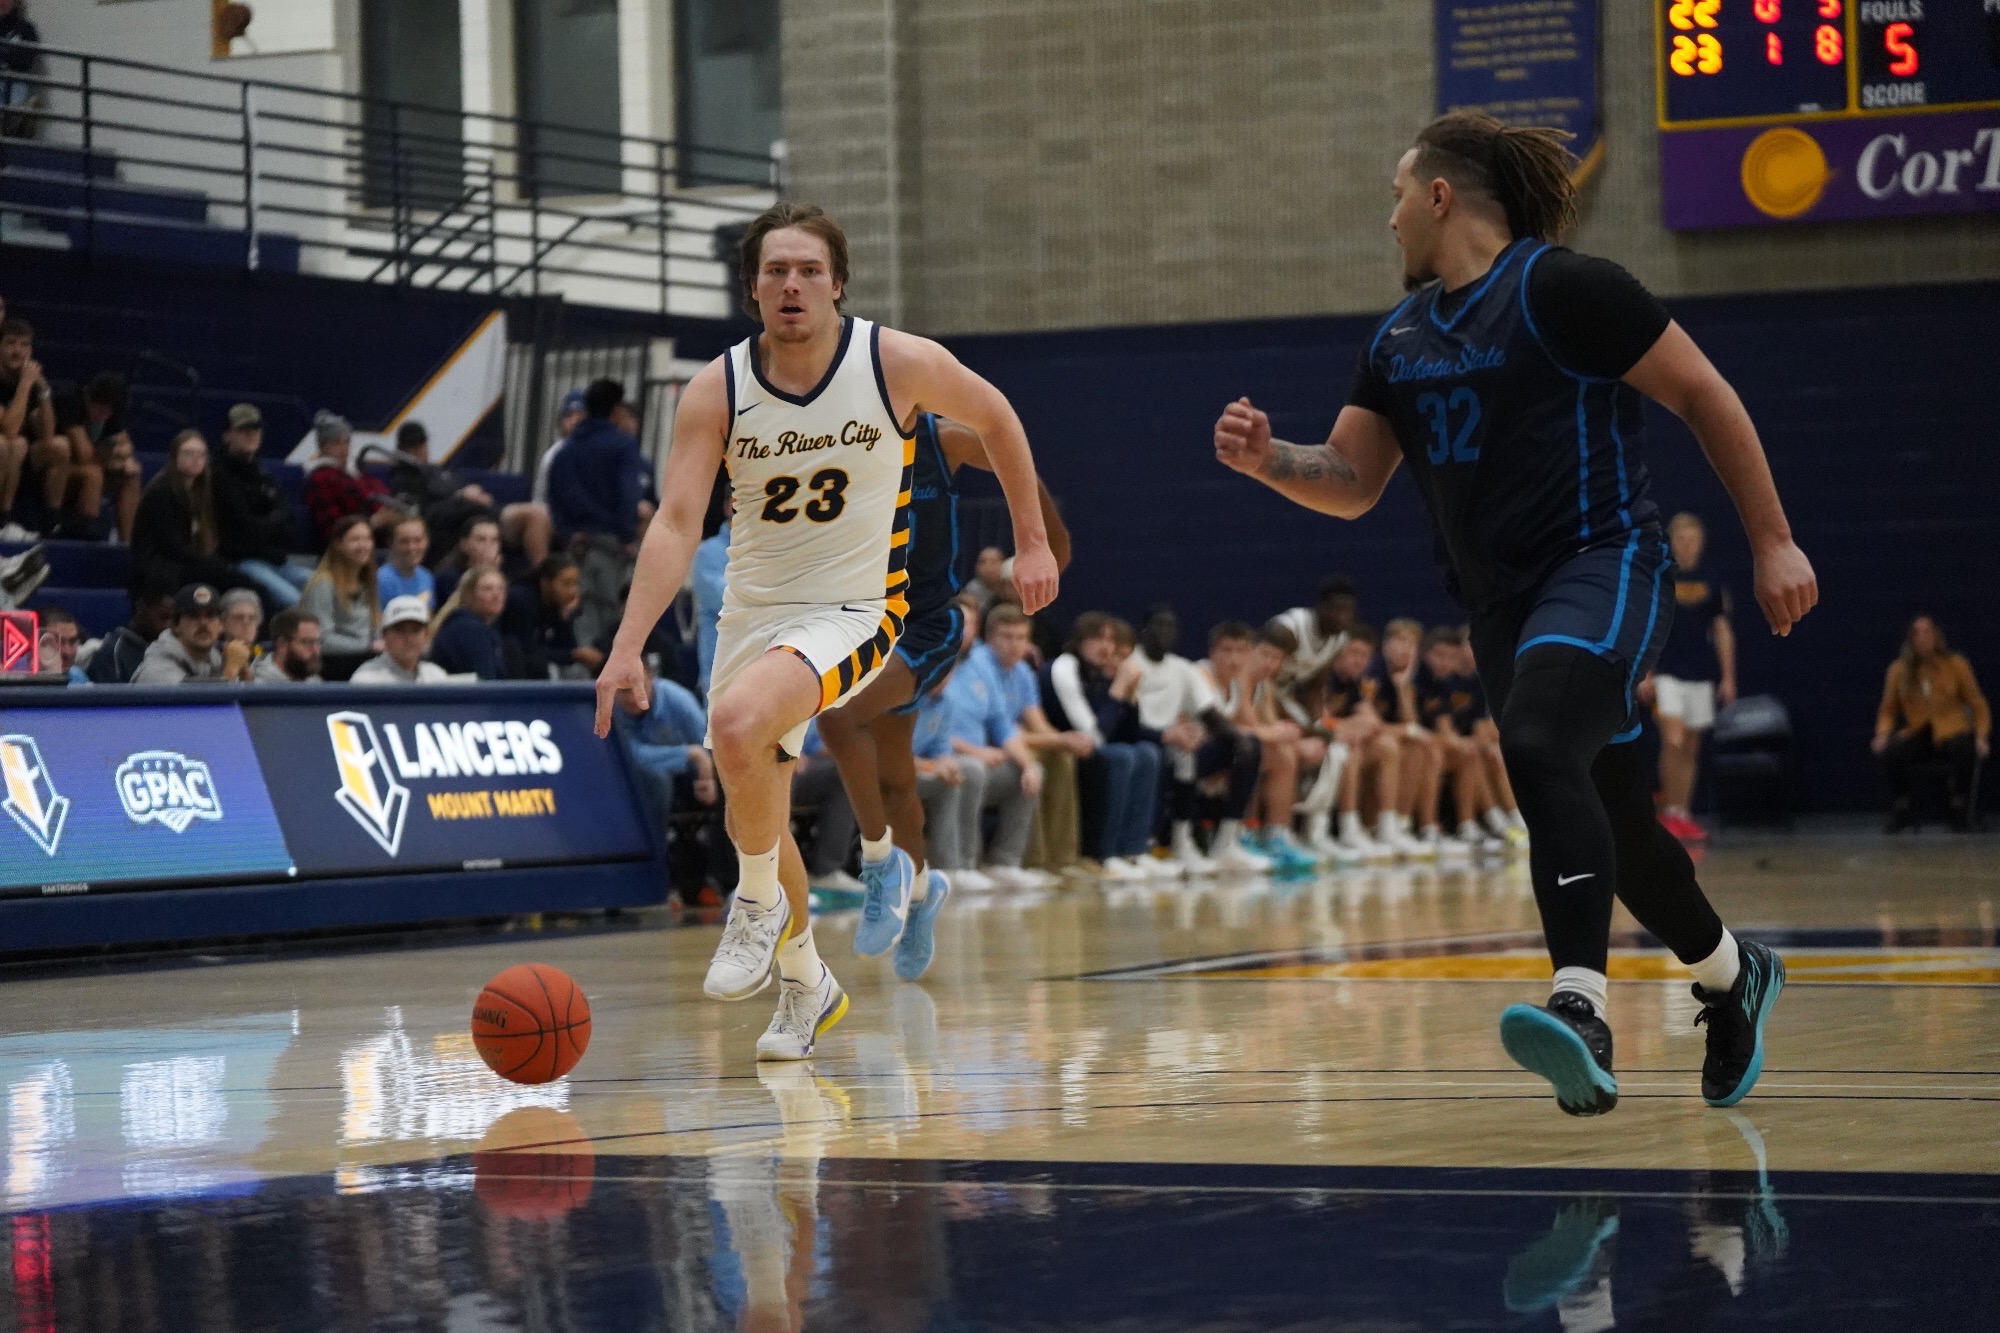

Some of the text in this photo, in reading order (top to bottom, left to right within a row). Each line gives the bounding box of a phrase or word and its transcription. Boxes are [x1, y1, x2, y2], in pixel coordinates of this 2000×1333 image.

[1860, 0, 1923, 22] FOULS
[1670, 24, 1843, 76] 23 1 8
[1885, 22, 1919, 75] 5
[1862, 81, 1925, 107] SCORE
[1388, 342, 1506, 384] Dakota State
[736, 420, 881, 459] The River City
[1416, 387, 1481, 465] 32
[760, 467, 850, 523] 23
[383, 719, 562, 778] LANCERS
[123, 770, 213, 812] GPAC
[427, 788, 556, 820] MOUNT MARTY
